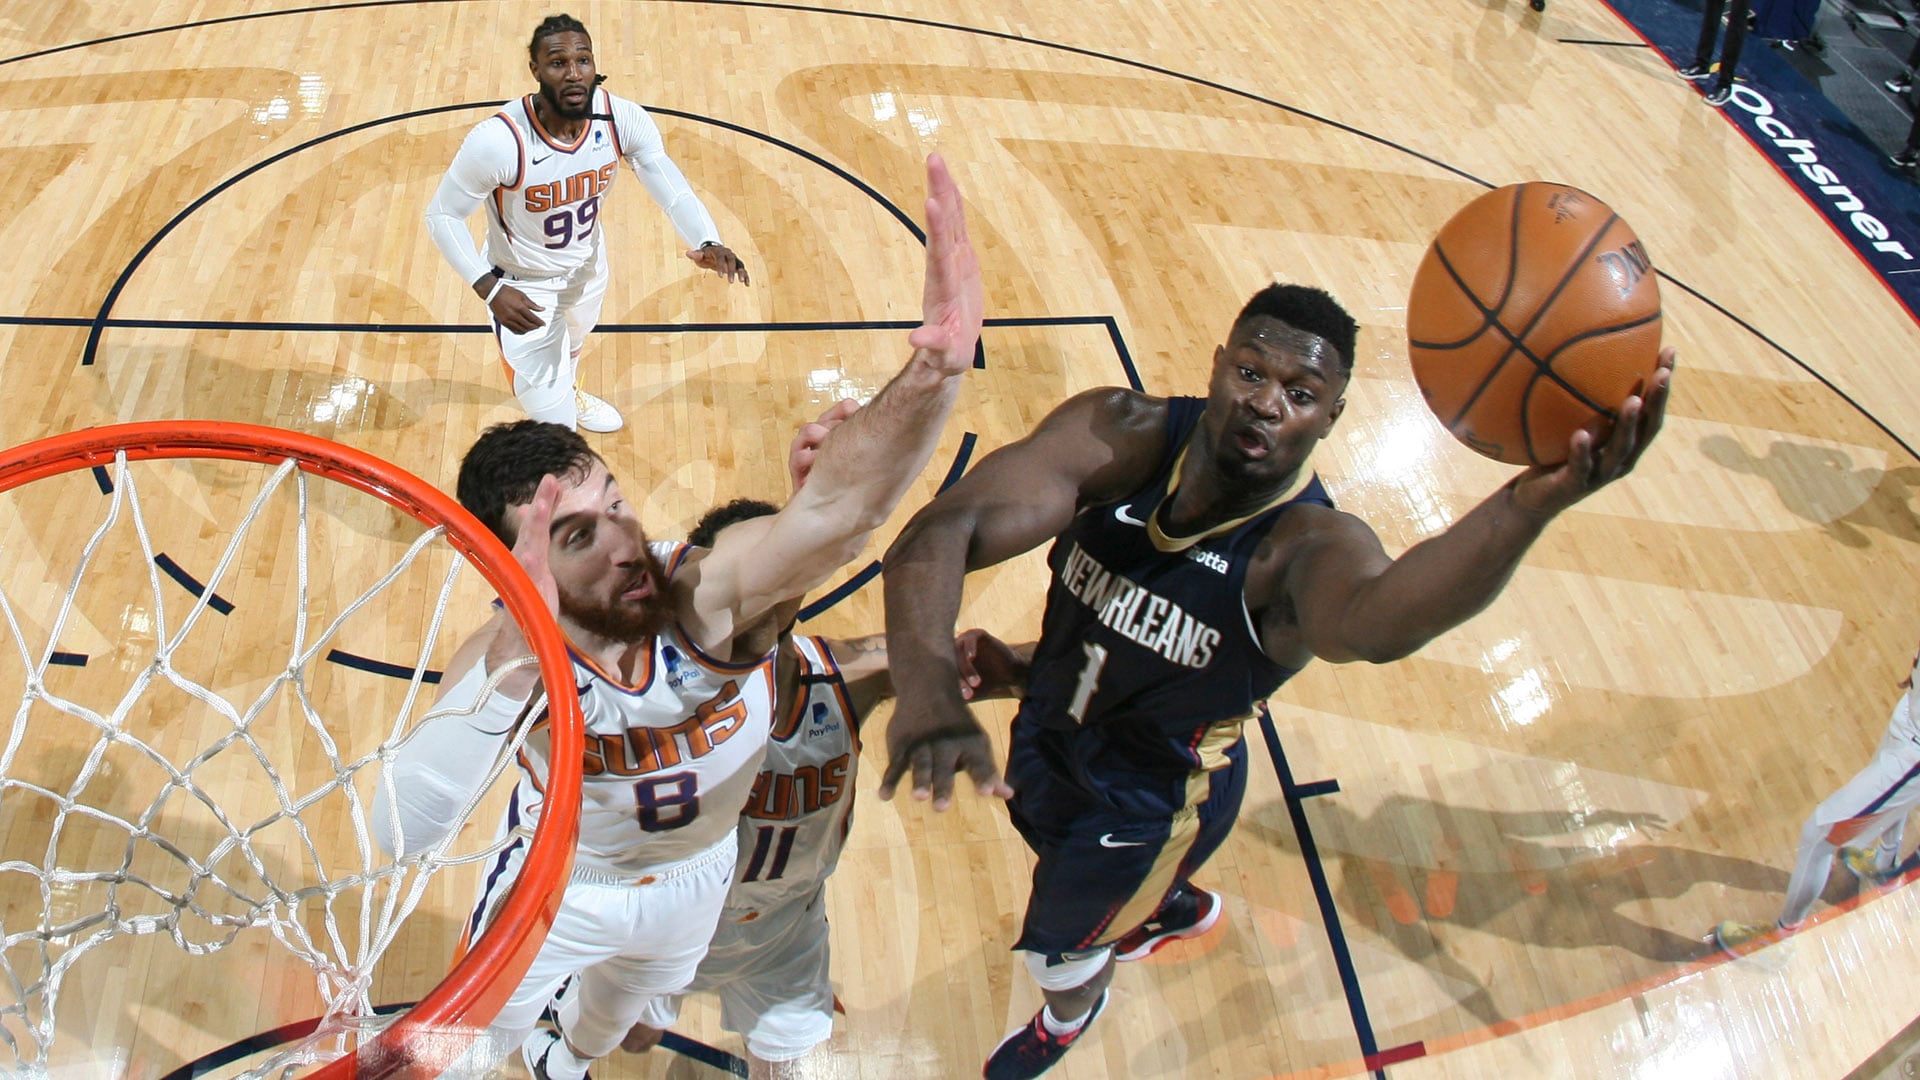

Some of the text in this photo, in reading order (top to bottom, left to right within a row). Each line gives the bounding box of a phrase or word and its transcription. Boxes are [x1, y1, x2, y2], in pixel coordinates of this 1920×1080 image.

[525, 160, 617, 213] SUNS
[1730, 84, 1914, 260] Ochsner
[544, 196, 599, 250] 99
[1189, 547, 1229, 575] otta
[1067, 640, 1109, 726] 1
[808, 721, 840, 739] PayPal
[633, 770, 700, 833] 8
[741, 824, 799, 884] 11
